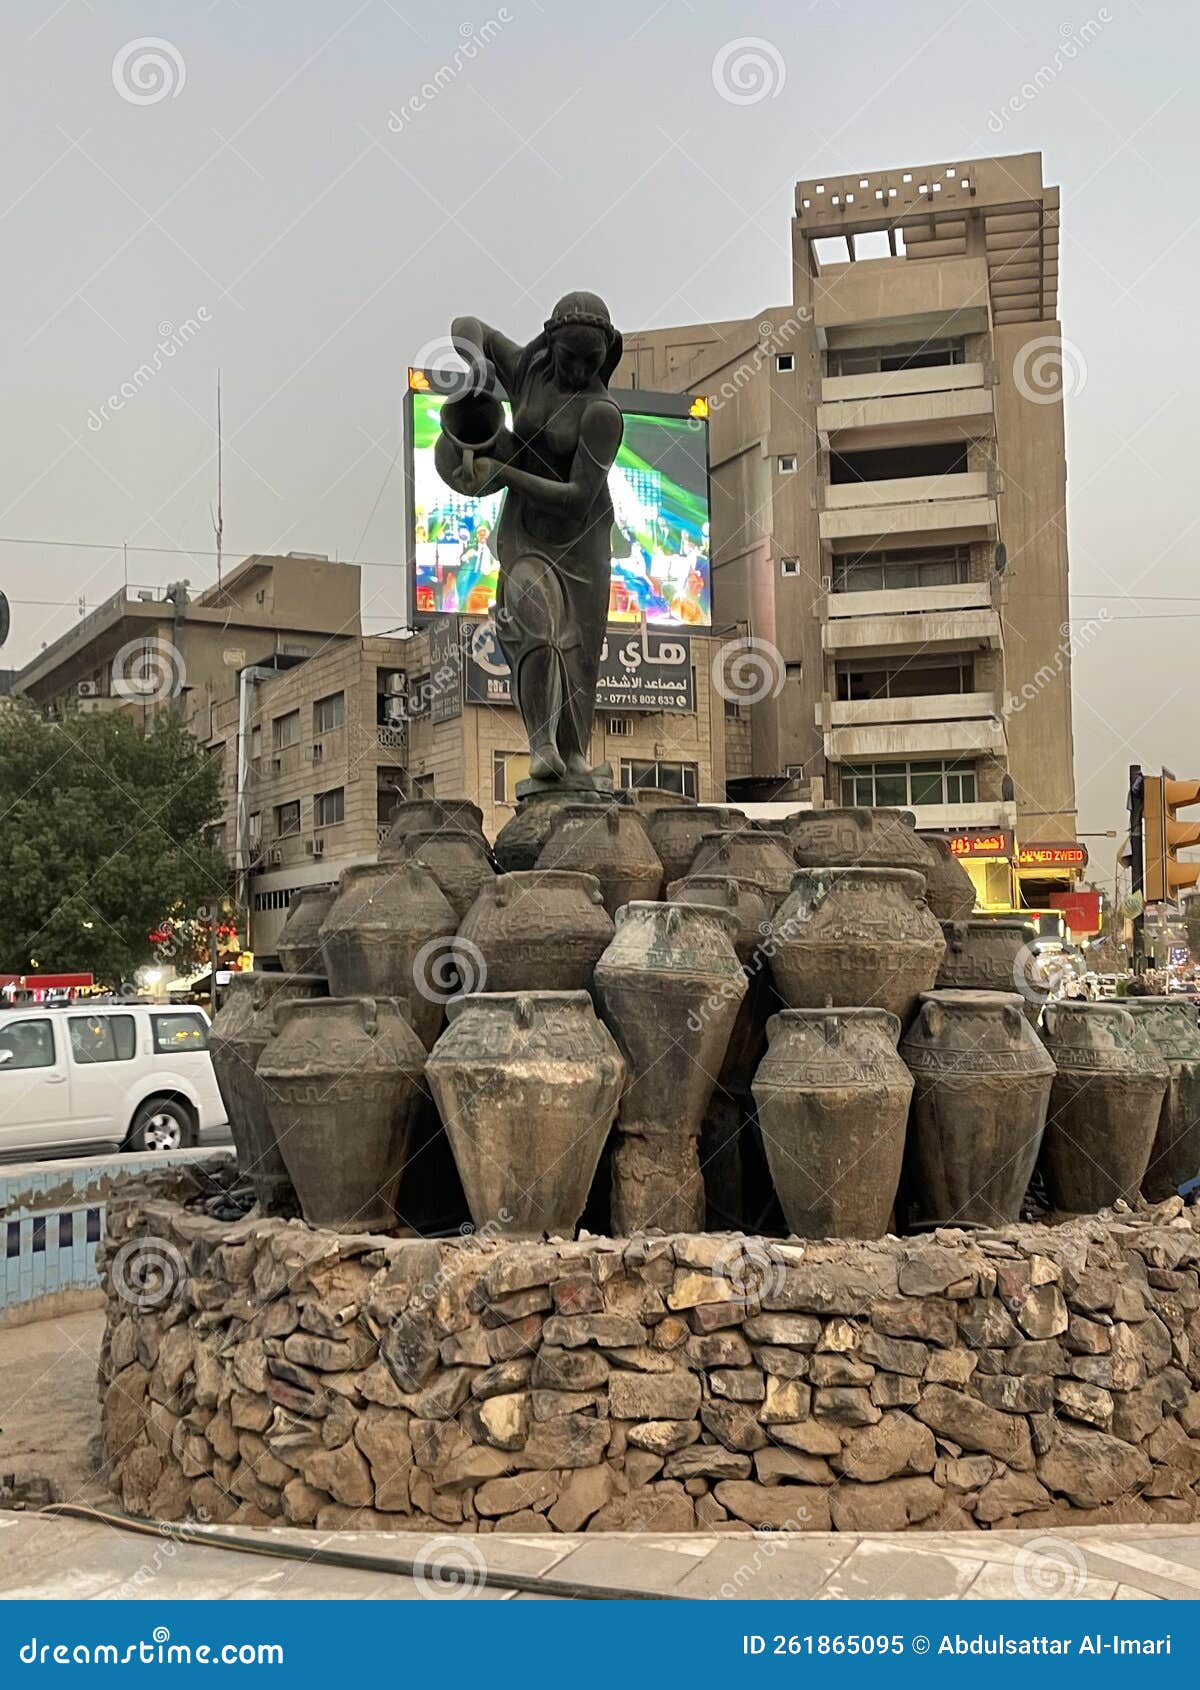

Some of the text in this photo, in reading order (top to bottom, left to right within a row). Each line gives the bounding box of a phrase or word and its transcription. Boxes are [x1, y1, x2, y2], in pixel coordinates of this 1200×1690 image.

[609, 694, 638, 704] 07715
[658, 695, 674, 705] 633
[1054, 850, 1084, 861] ZWEID
